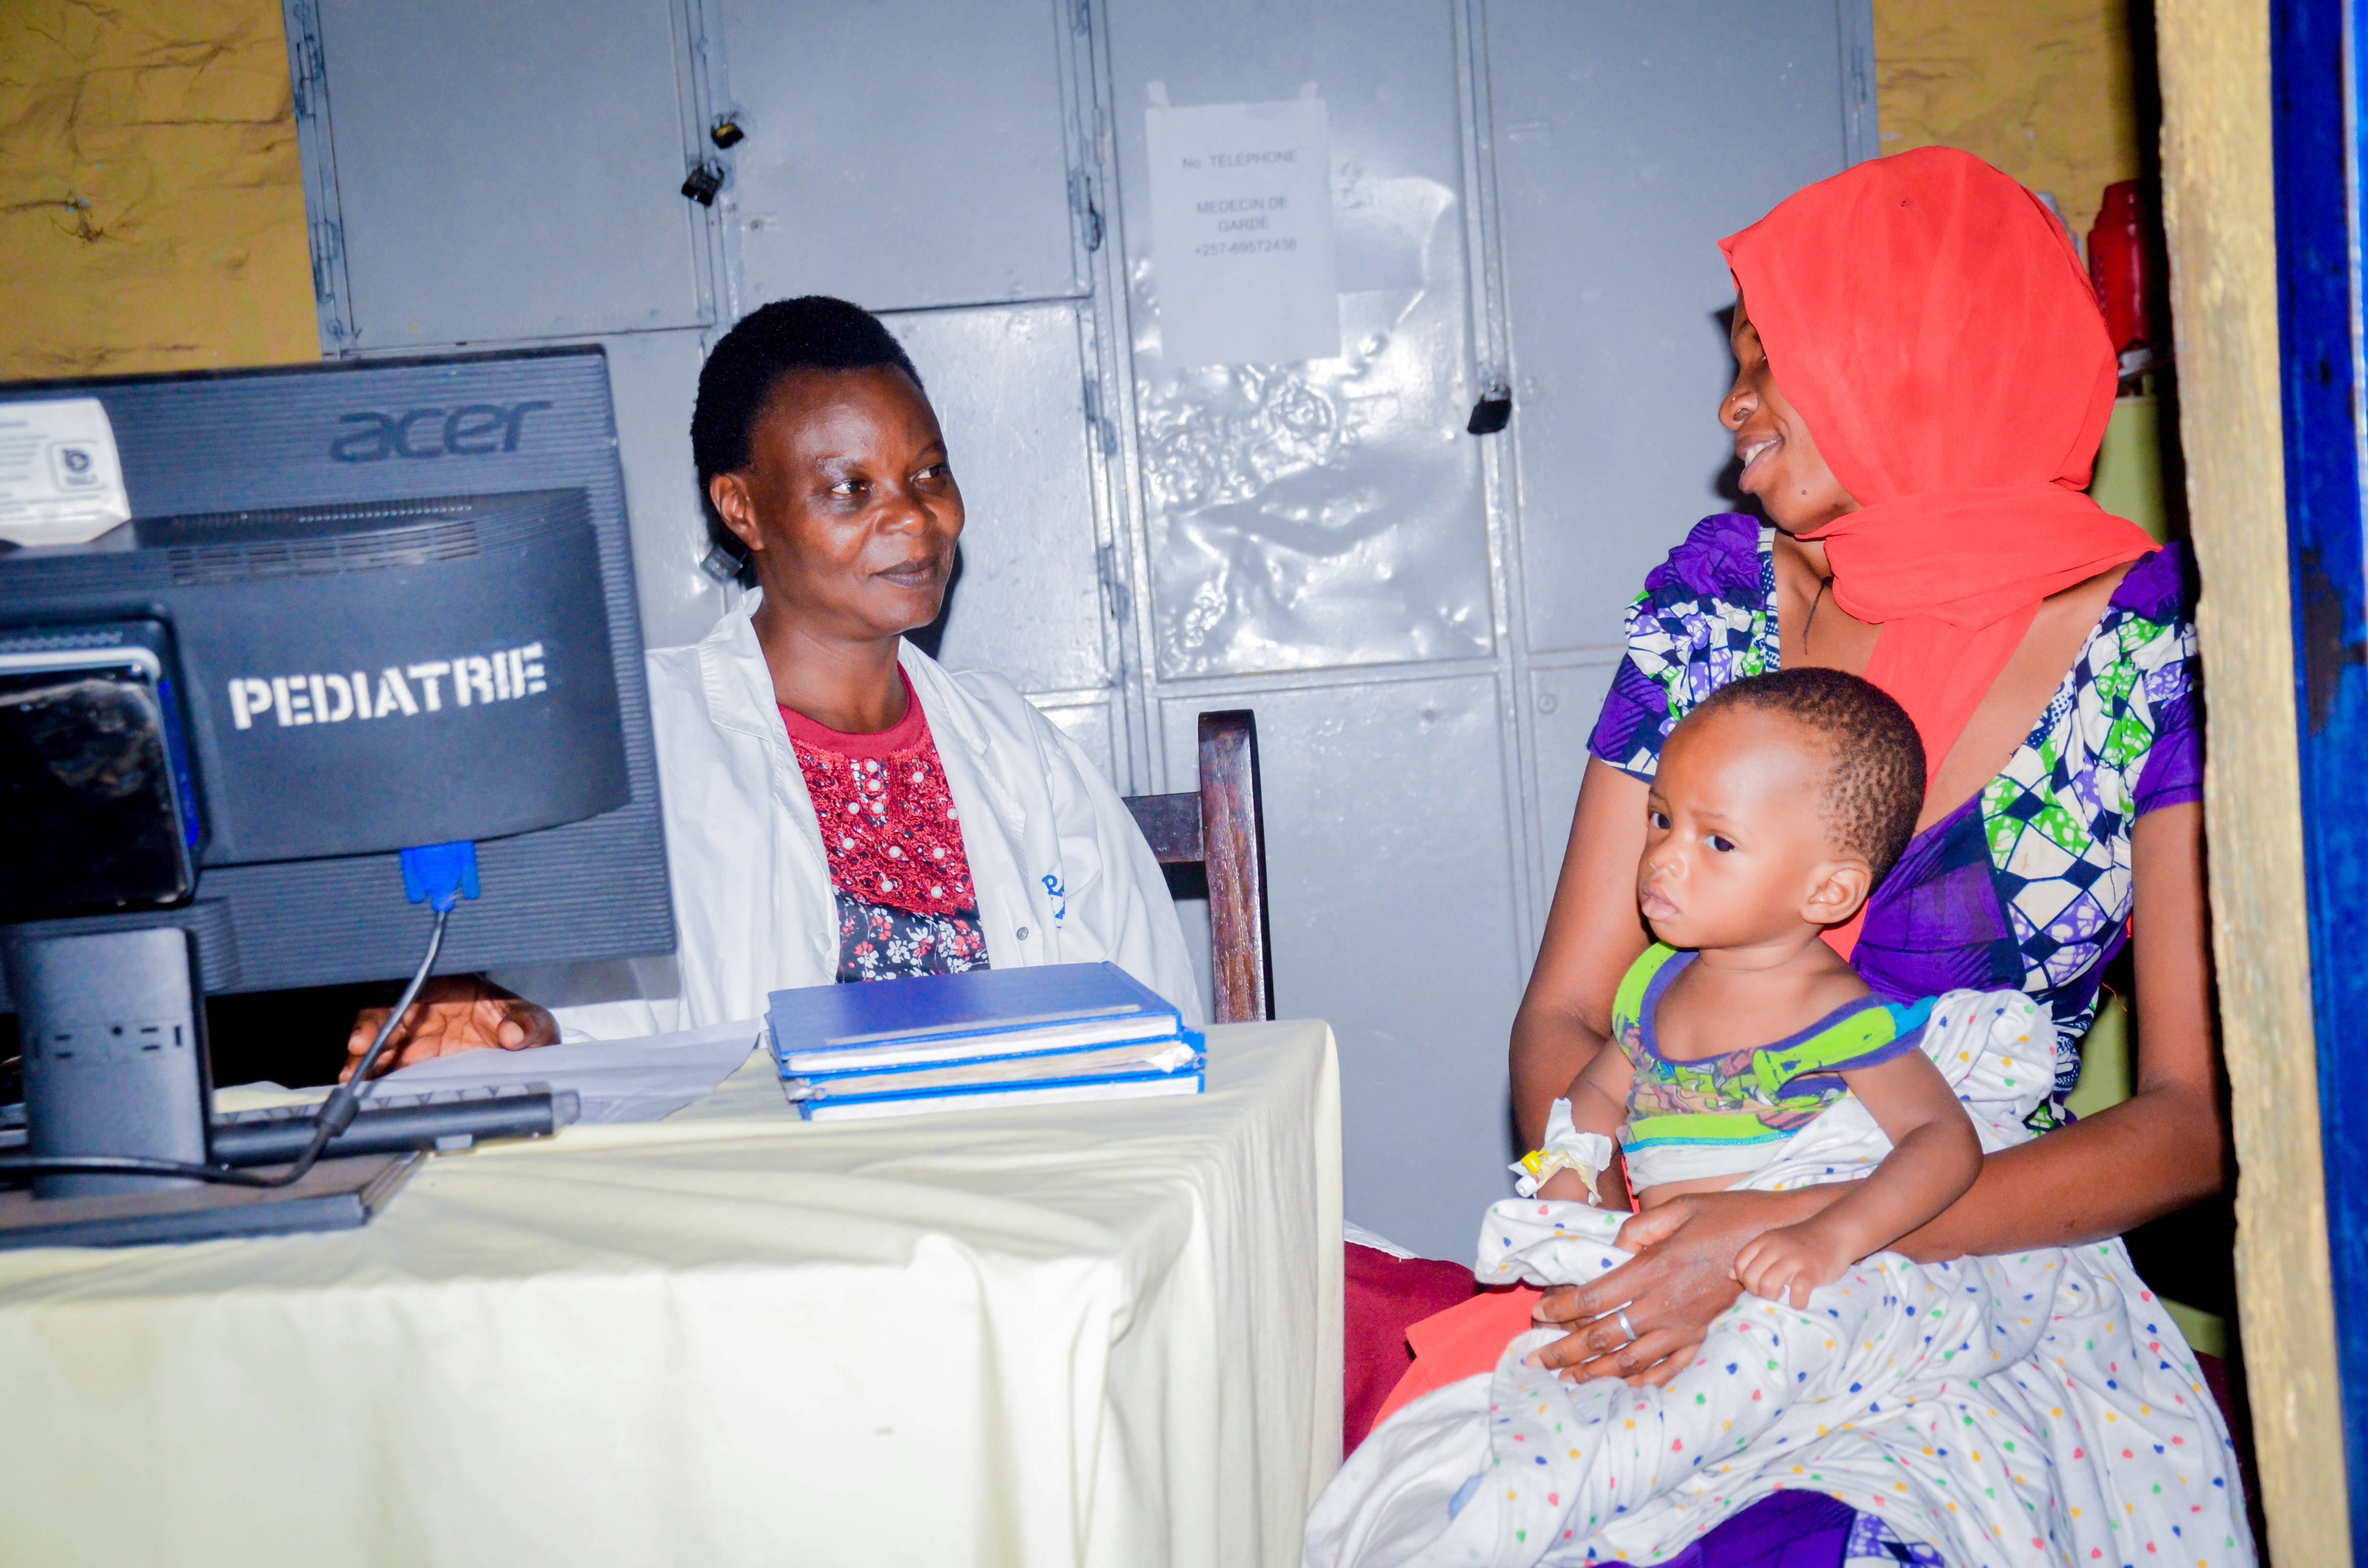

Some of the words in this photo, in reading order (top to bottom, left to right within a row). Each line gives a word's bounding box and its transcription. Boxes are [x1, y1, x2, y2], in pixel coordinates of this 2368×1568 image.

[1269, 196, 1289, 209] DE
[1218, 217, 1270, 233] GARDE
[331, 401, 554, 462] acer
[228, 642, 547, 730] PEDIATRIE
